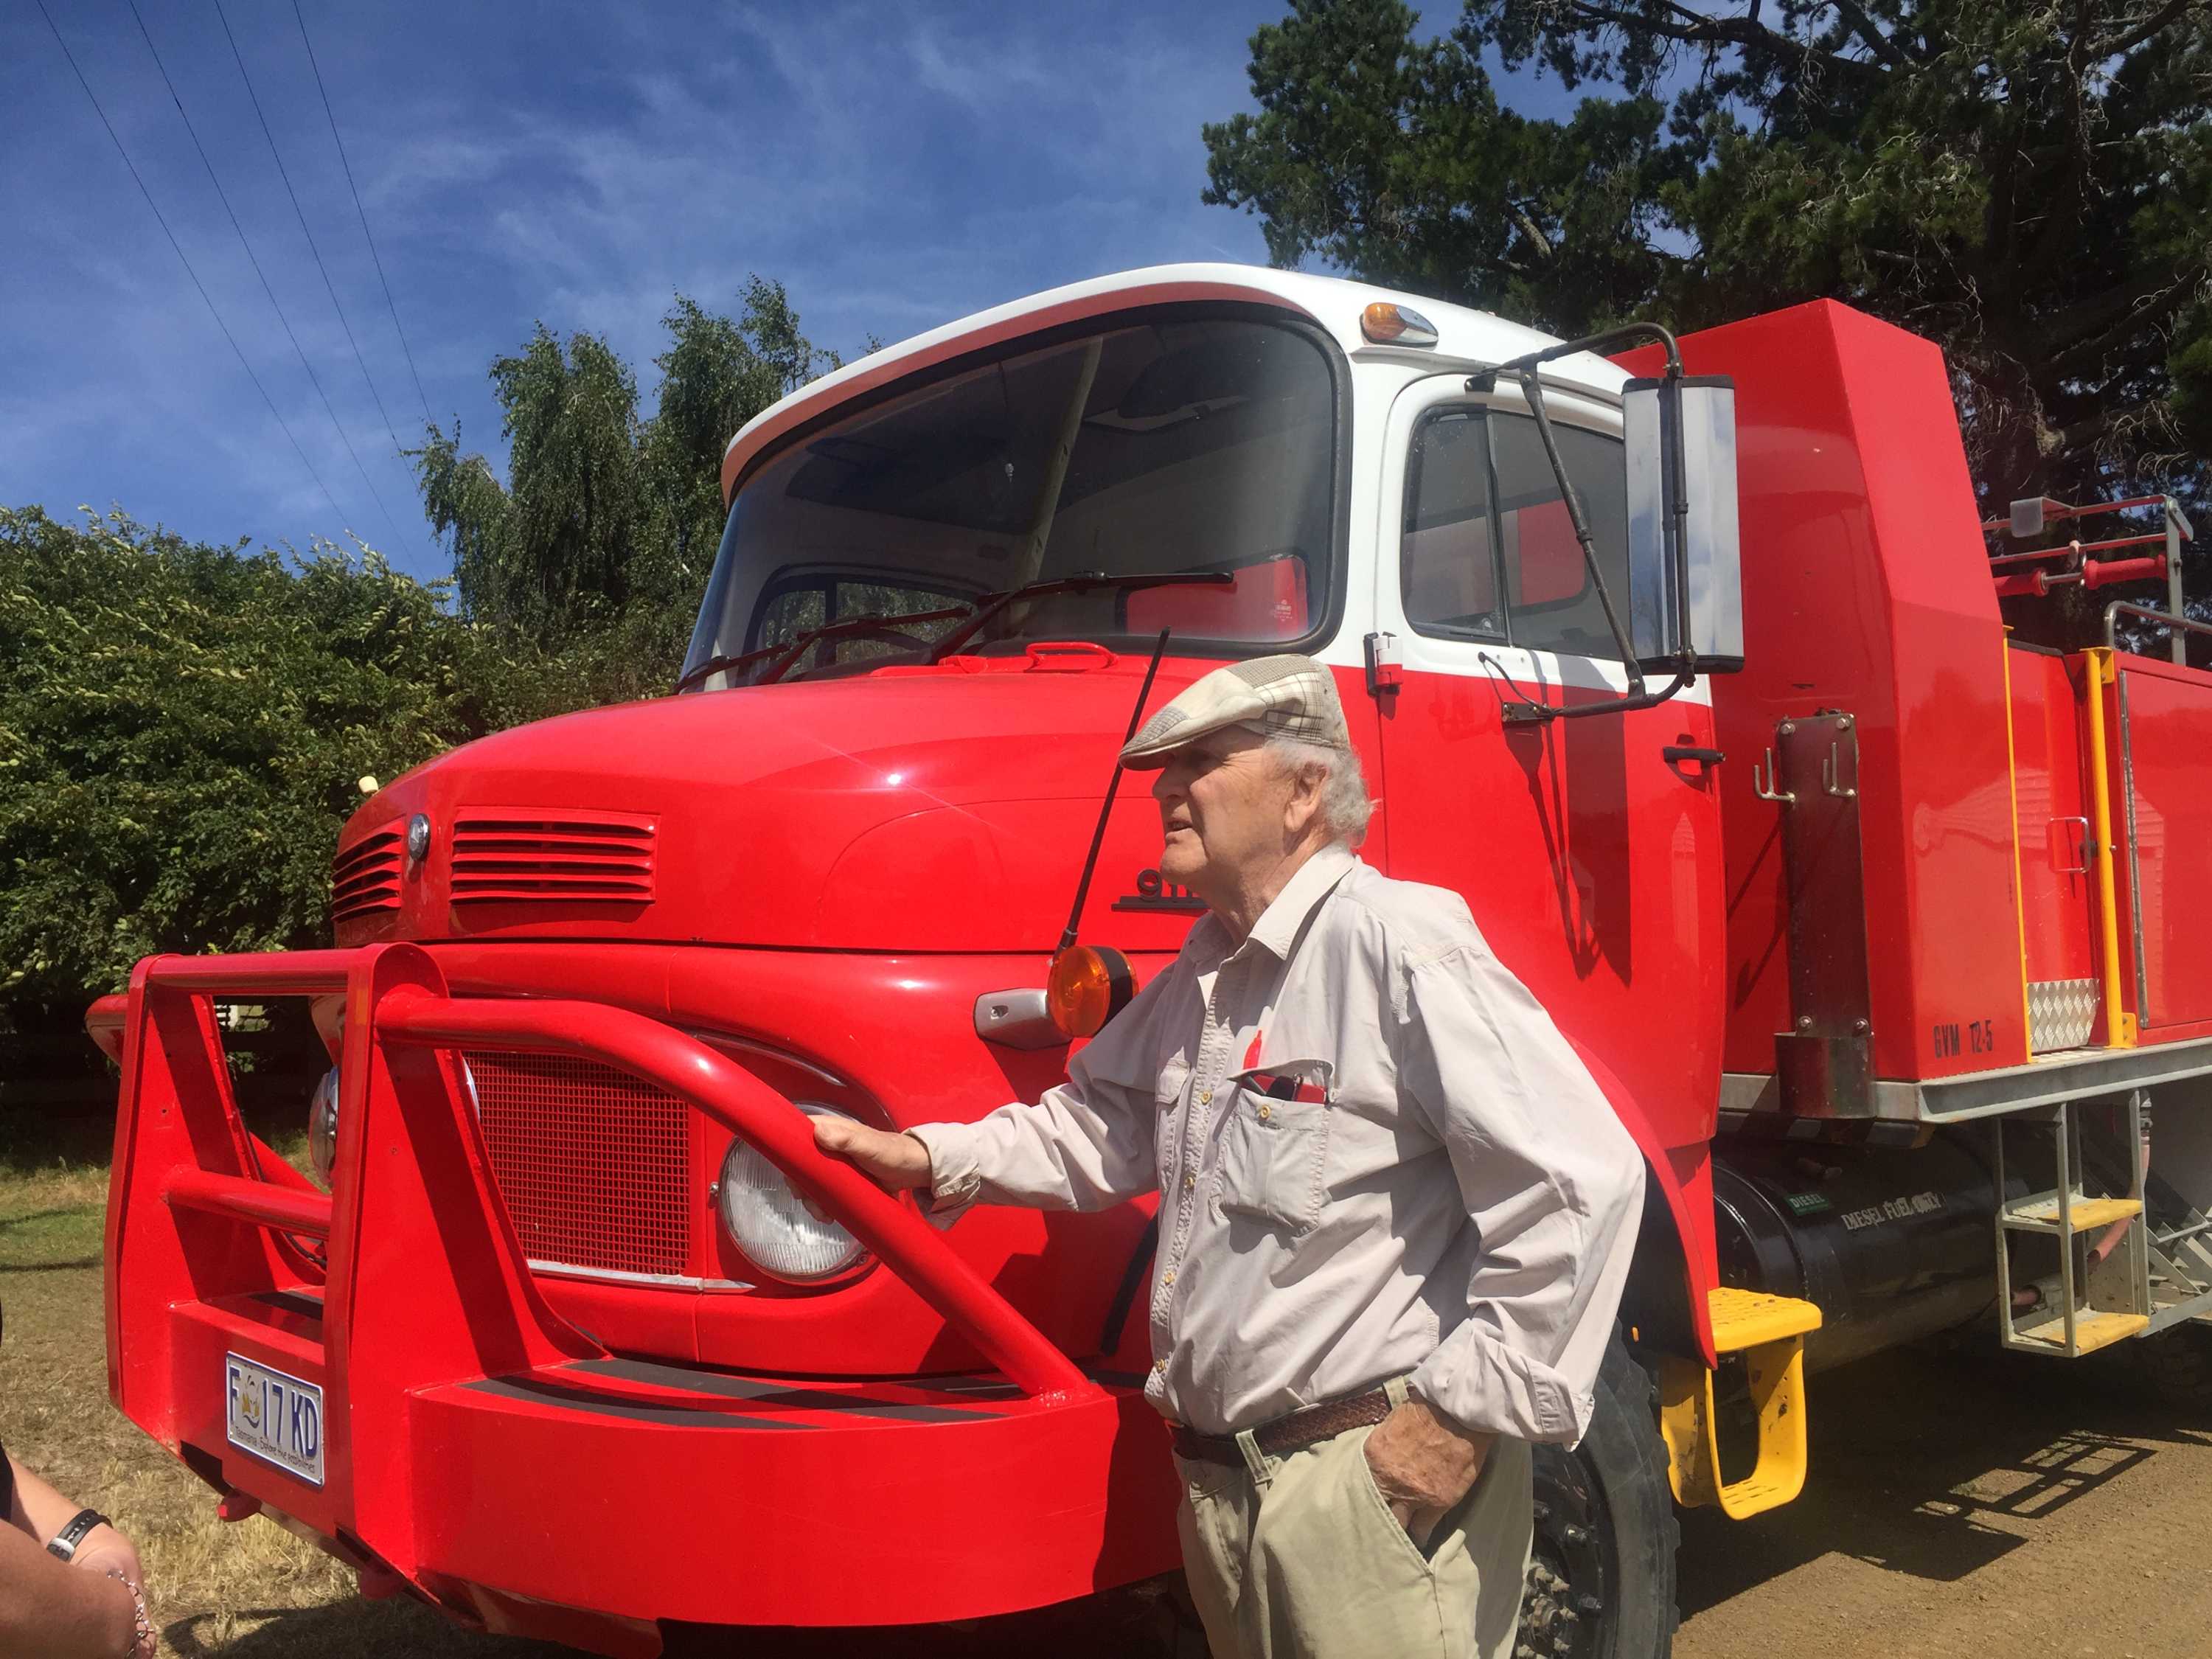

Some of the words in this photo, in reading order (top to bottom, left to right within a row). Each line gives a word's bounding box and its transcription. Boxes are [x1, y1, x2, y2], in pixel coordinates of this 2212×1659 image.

[1933, 1023, 1960, 1058] GVM
[1790, 1194, 1825, 1208] DIESEL
[1840, 1206, 1885, 1230] DIESEL
[1882, 1197, 1914, 1220] FUEL
